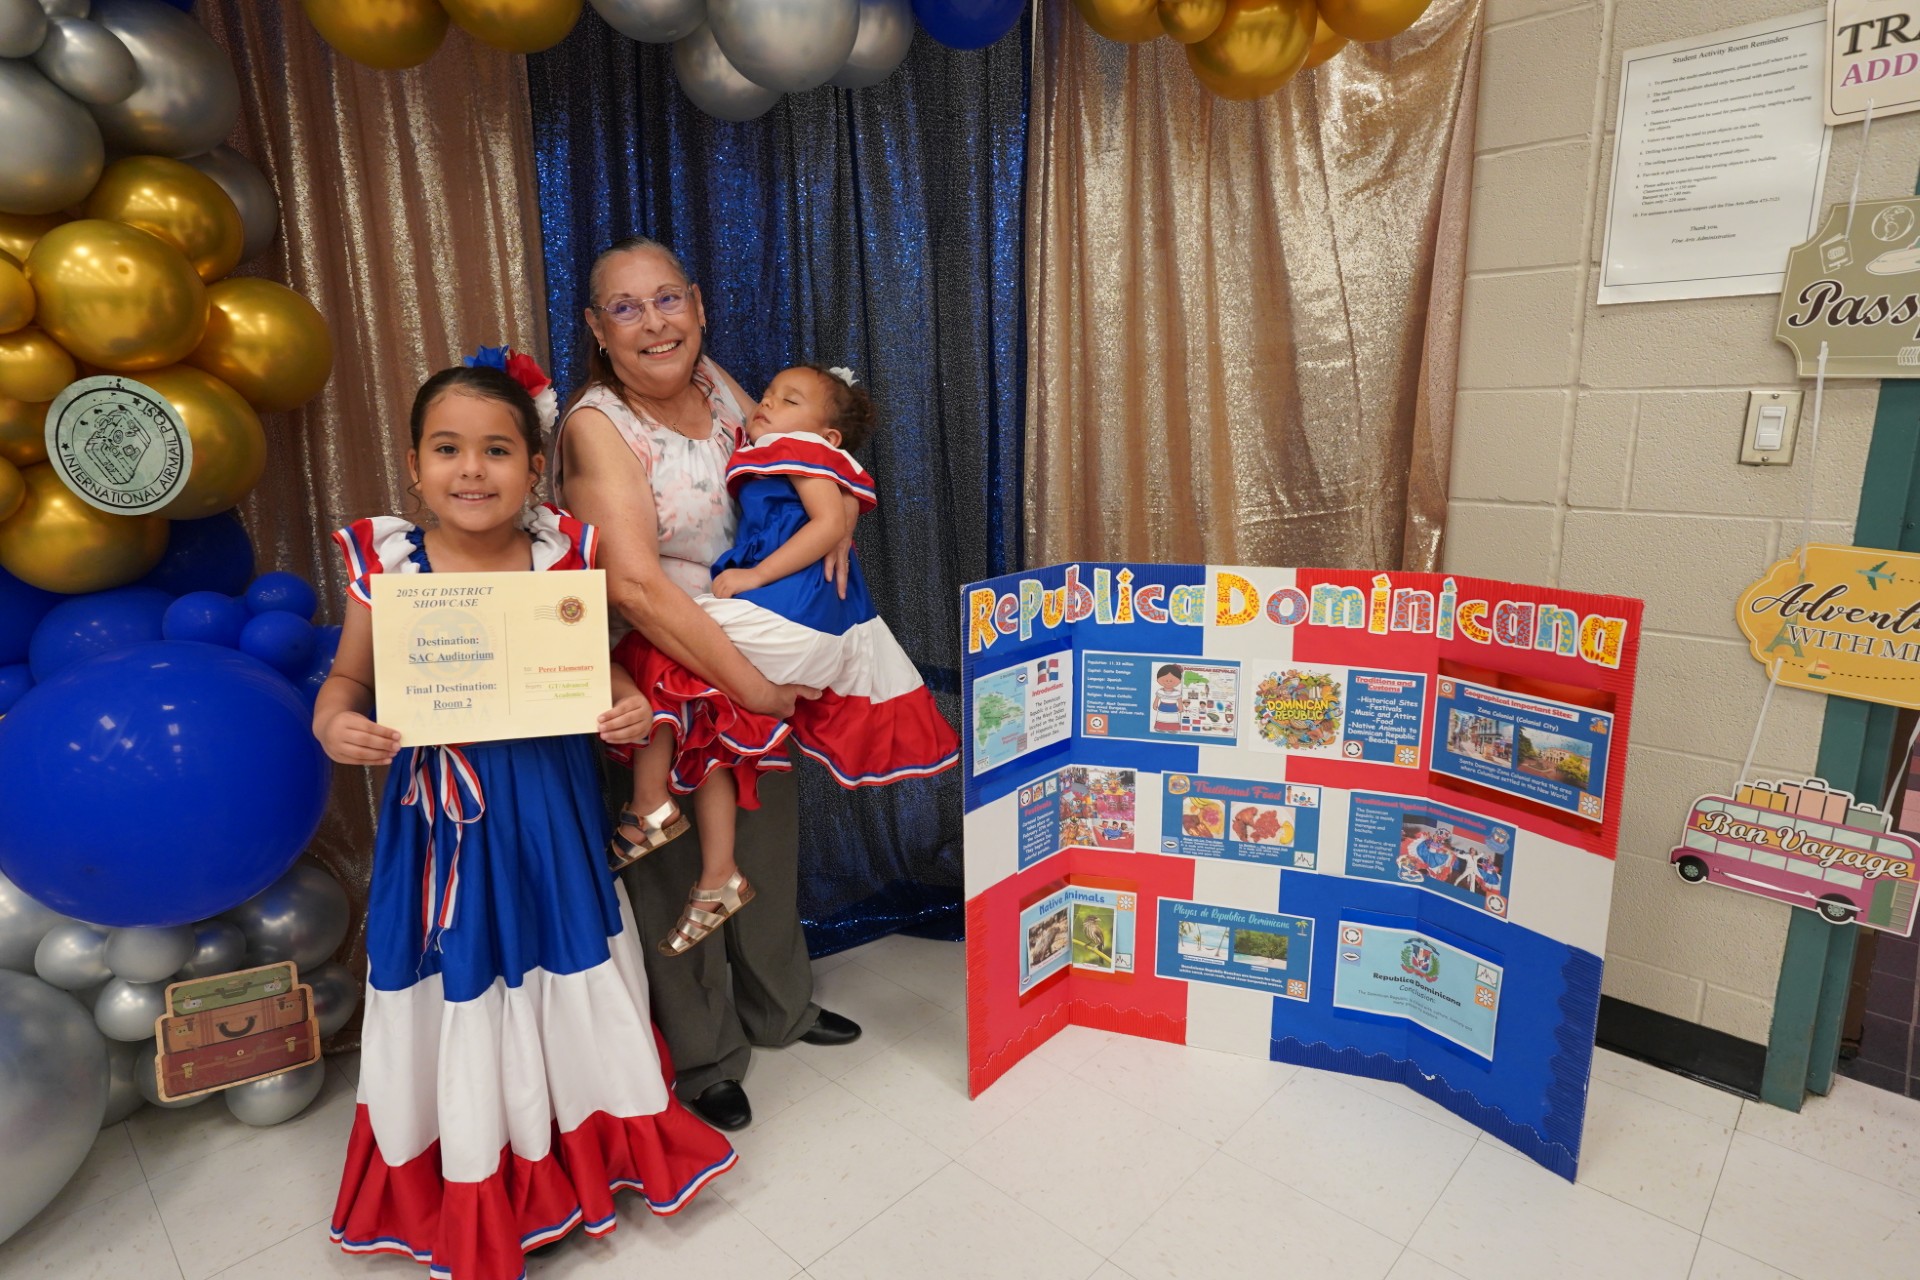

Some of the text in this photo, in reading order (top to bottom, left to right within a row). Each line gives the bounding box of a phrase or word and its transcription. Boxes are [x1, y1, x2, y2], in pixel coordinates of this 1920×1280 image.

[1837, 13, 1920, 56] TR
[1672, 35, 1789, 64] Student Activity Room Reminders
[1788, 280, 1920, 340] Pass
[63, 453, 161, 505] INTERNATIONAL
[159, 437, 181, 491] AIRMAIL
[395, 586, 495, 598] 2025 GT DISTRICT
[413, 598, 479, 609] SHOWCASE
[1215, 573, 1628, 669] Dominicana
[416, 636, 480, 647] Destination:
[1788, 625, 1875, 656] WITH
[408, 650, 495, 664] SAC Auditorium
[406, 682, 498, 695] Final Destination:
[1356, 676, 1413, 688] Traditions and
[1368, 684, 1401, 692] Customs
[433, 697, 473, 710] Room 2
[1266, 699, 1329, 711] DOMINICAN
[1399, 699, 1419, 708] Sites
[1464, 688, 1573, 720] Geographical Important Sites:
[1275, 709, 1325, 721] REPUBLIC
[1393, 713, 1417, 721] Attire
[1477, 706, 1559, 732] Zona Colonial (Colonial City)
[1347, 728, 1416, 741] Dominican Republic
[1378, 725, 1407, 733] Animals
[1192, 781, 1282, 800] Traditional Food
[1700, 811, 1908, 880] Bon Voyage
[1039, 890, 1105, 916] Native Animals
[1173, 903, 1198, 919] Playas
[1200, 907, 1208, 918] de
[1248, 913, 1290, 929] Dominicana
[1373, 971, 1462, 1008] Republica Dominicana
[1399, 984, 1436, 1004] Conclusion:
